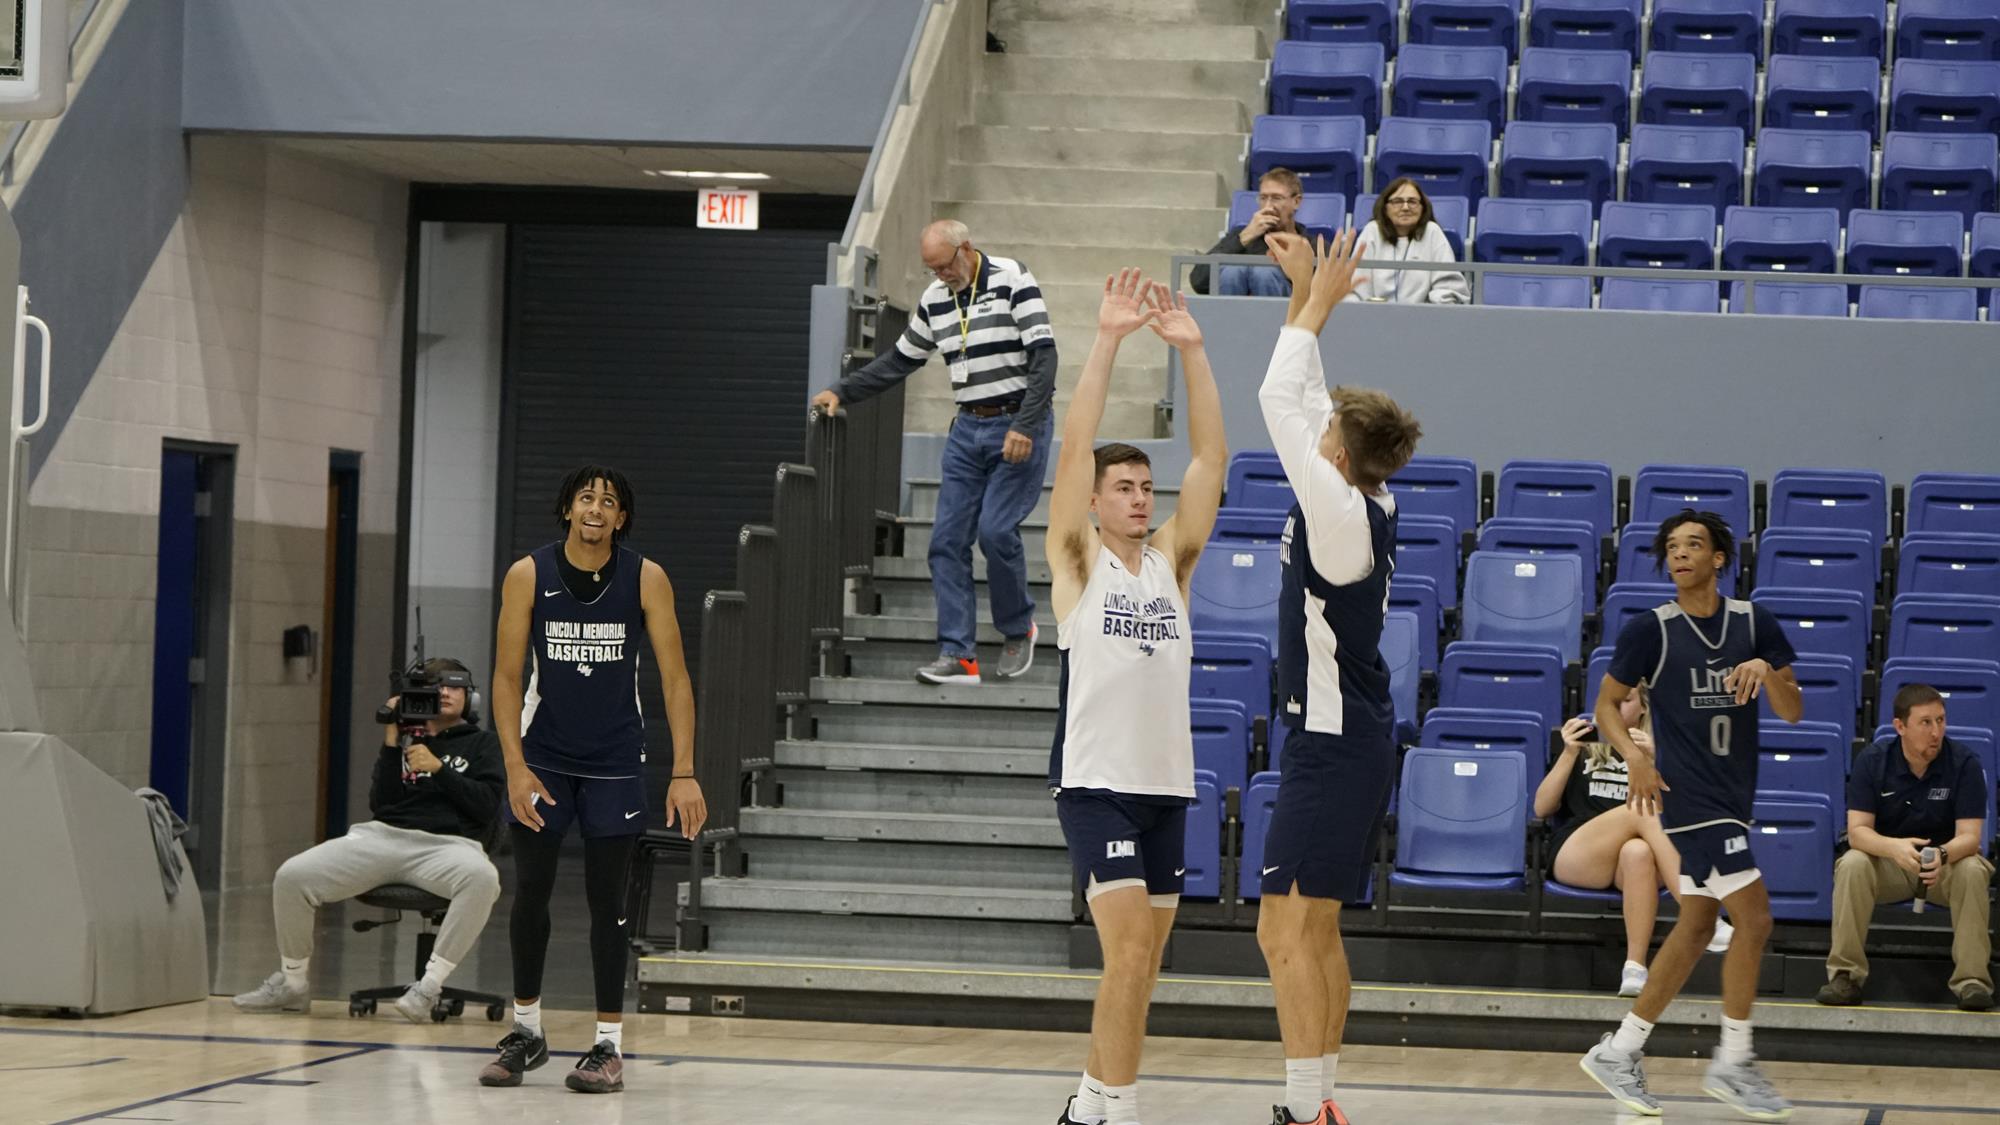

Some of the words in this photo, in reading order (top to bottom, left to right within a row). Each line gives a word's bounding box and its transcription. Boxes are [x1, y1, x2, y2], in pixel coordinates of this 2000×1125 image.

[707, 193, 749, 224] EXIT
[545, 621, 580, 639] LINCOLN
[582, 623, 626, 639] MEMORIAL
[547, 643, 624, 662] BASKETBALL
[1710, 714, 1731, 756] 0
